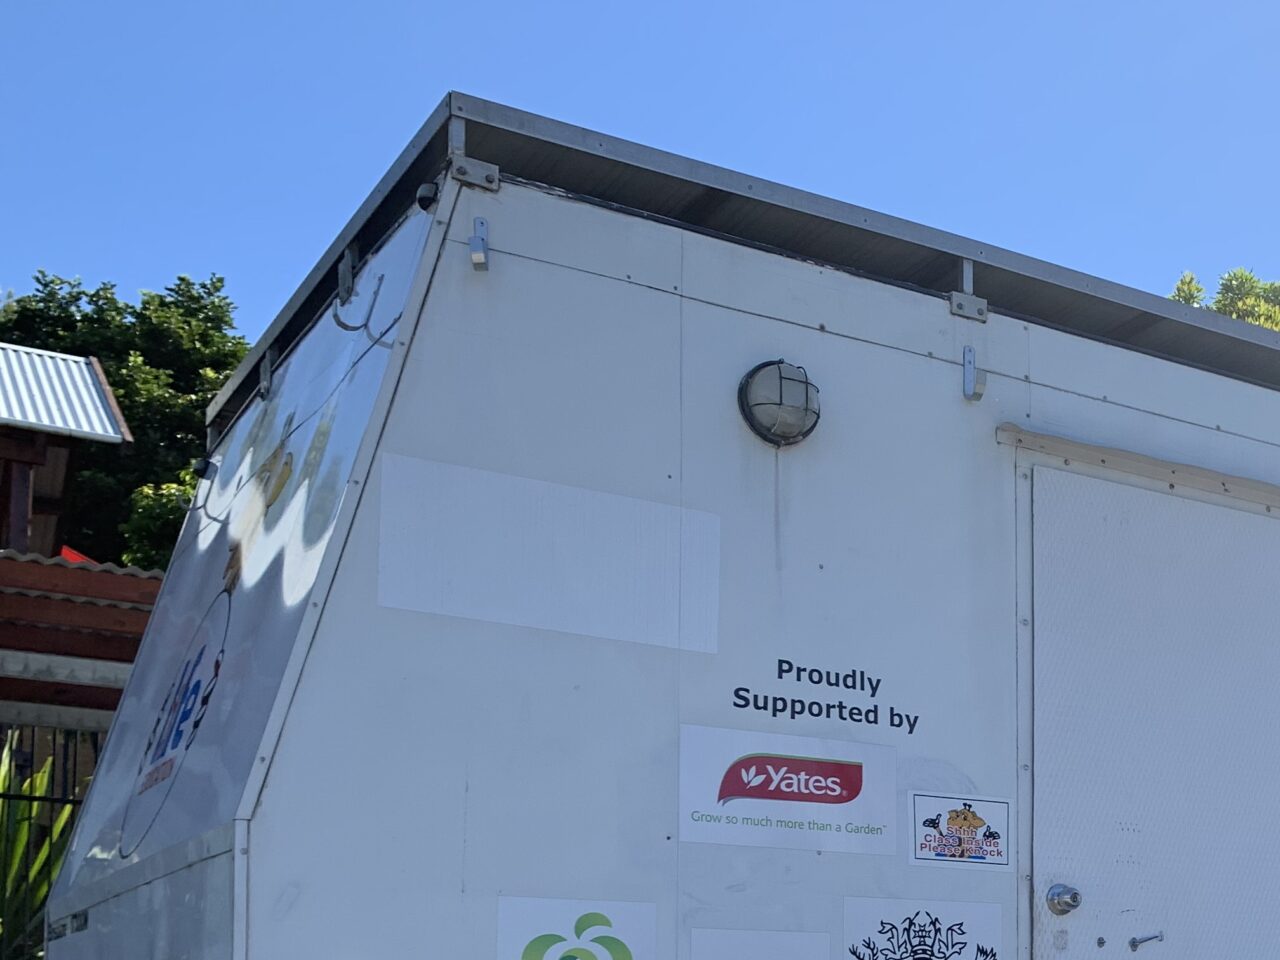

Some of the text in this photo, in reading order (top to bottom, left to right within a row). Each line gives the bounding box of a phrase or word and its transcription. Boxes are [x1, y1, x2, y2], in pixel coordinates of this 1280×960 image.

[776, 658, 882, 698] Proudly
[732, 687, 920, 734] Supported by
[765, 764, 842, 796] Yates
[690, 810, 883, 836] Grow so much more than a Garden
[946, 826, 977, 837] Shhh
[920, 843, 1003, 858] Please Knock
[924, 833, 1000, 848] Class Inside
